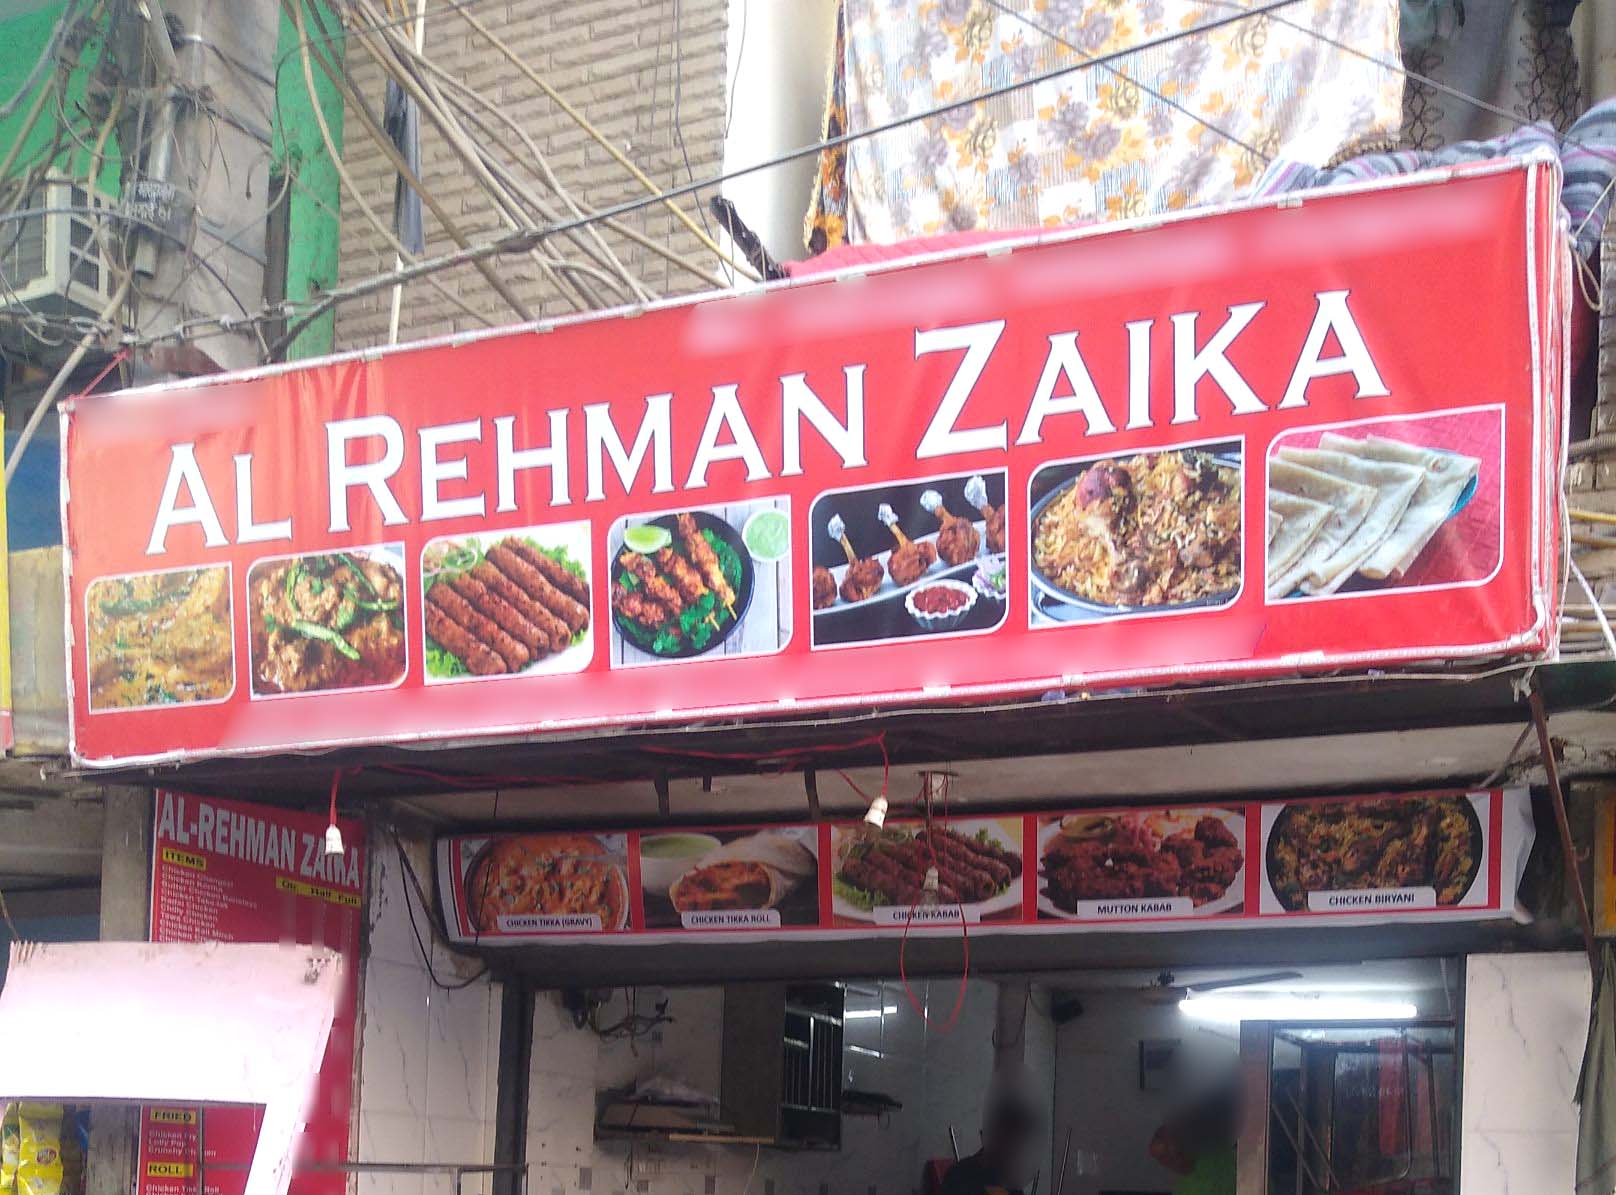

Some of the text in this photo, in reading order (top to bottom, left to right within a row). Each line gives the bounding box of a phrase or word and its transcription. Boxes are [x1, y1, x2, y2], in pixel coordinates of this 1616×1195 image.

[145, 290, 1391, 556] AL REHMAN ZAIKA
[158, 792, 296, 872] AL-REHMAN
[165, 851, 204, 867] ITEMS
[1328, 893, 1415, 906] CHICKEN BIRYANI
[1097, 902, 1172, 915] MUTTON KABAB
[691, 914, 770, 925] CHICKEN TIKKA ROLL
[892, 909, 960, 920] CHICKEN KABAB
[506, 917, 593, 928] CHICKEN TIKKA (GRAVY)
[153, 1111, 192, 1121] FRIED
[149, 1164, 182, 1174] ROLL
[145, 1184, 179, 1192] Chicken
